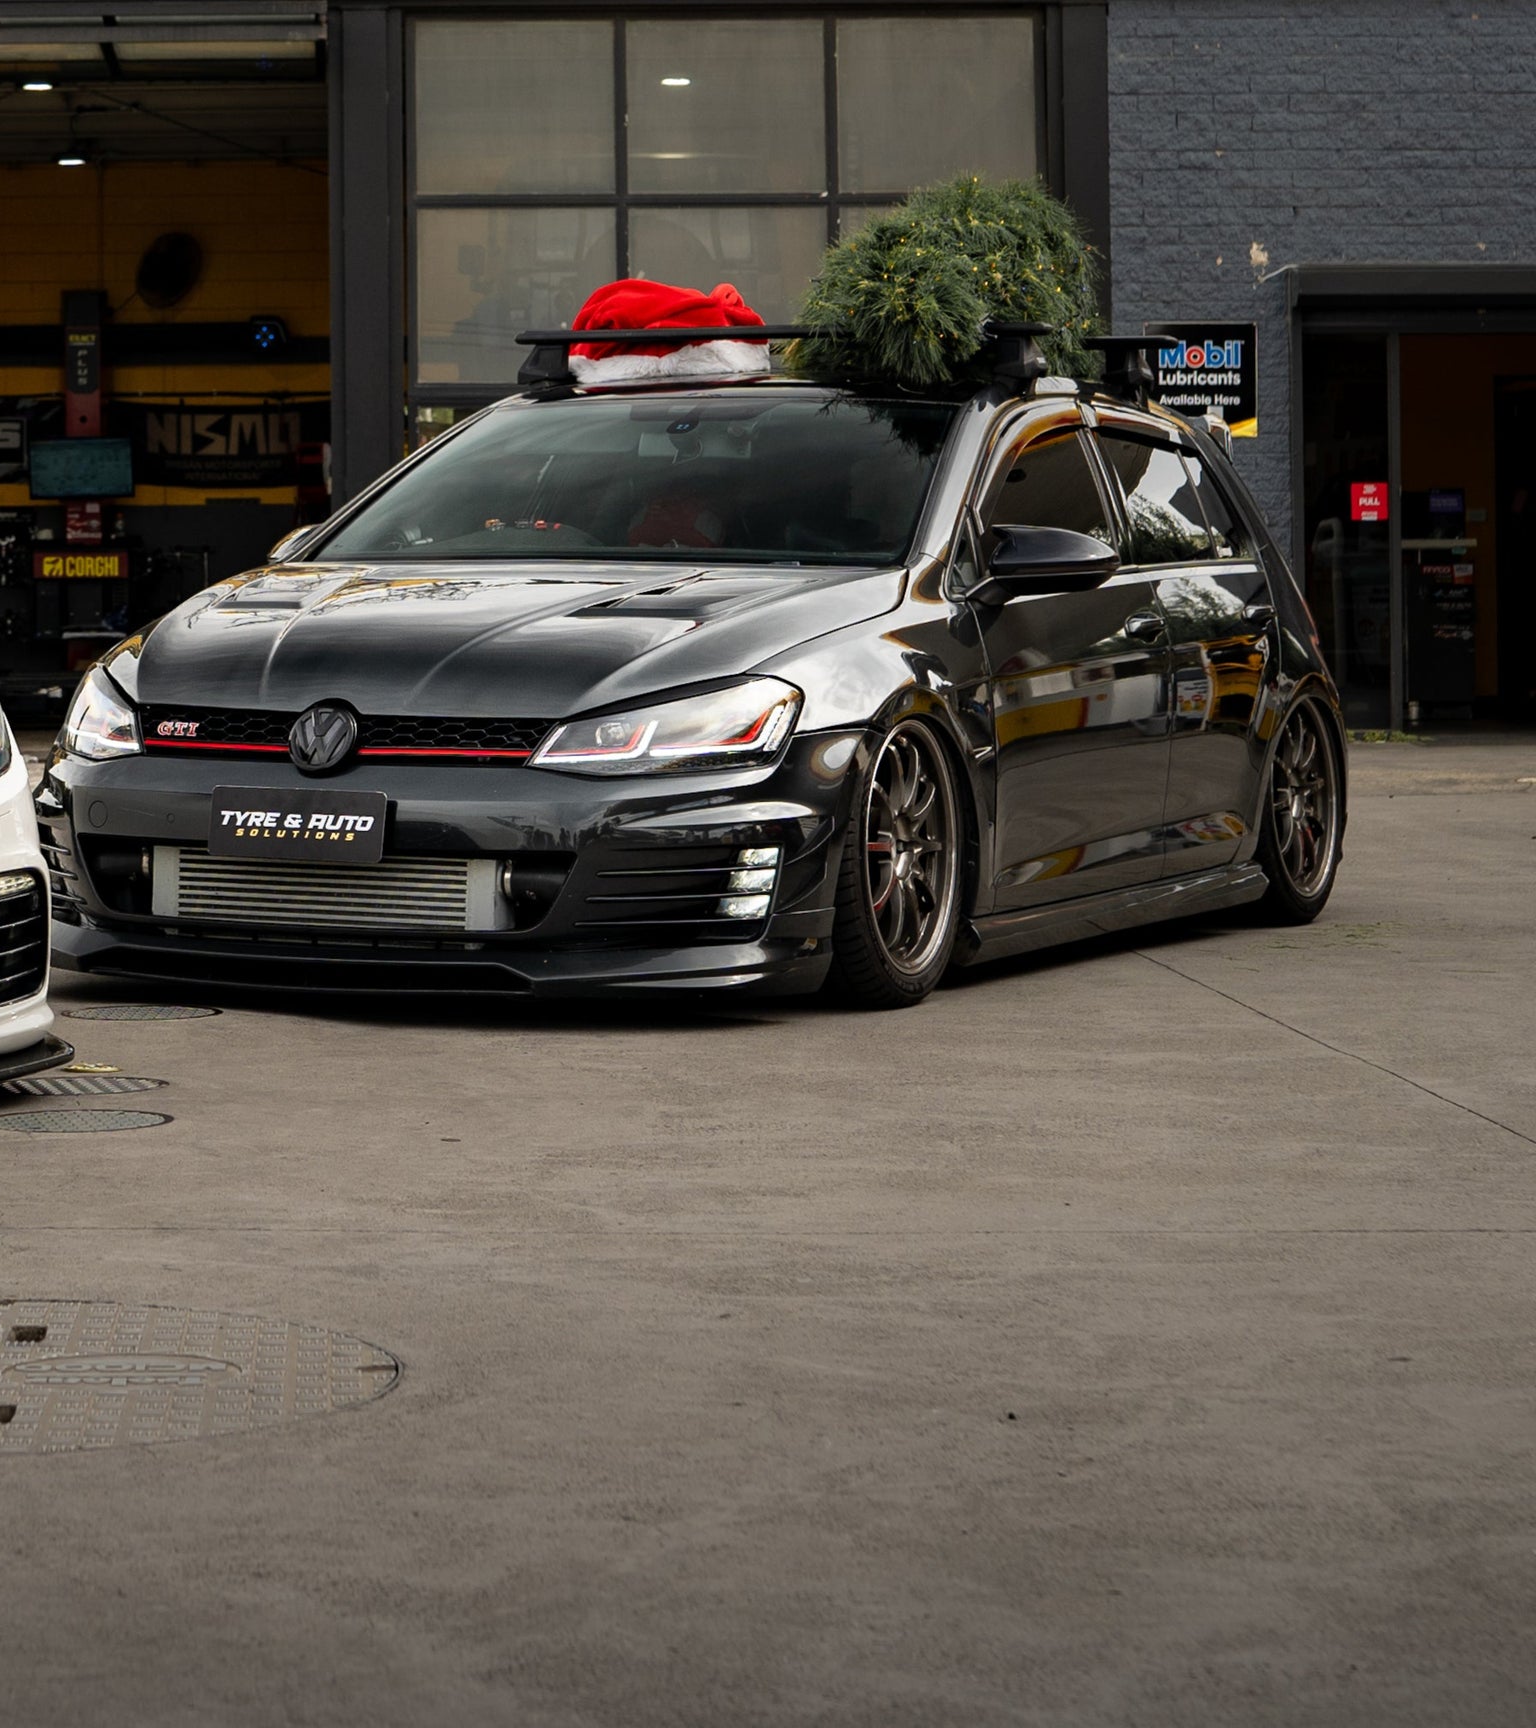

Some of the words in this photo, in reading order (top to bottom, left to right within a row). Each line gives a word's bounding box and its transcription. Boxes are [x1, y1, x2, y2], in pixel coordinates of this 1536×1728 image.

[1158, 340, 1241, 369] Mobil
[77, 350, 89, 385] PLUS
[1158, 371, 1241, 385] Lubricants
[1159, 394, 1212, 405] Available
[1214, 394, 1241, 405] Here
[146, 412, 301, 455] NISMO
[1359, 497, 1381, 506] PULL
[65, 556, 119, 577] CORGHI
[157, 721, 200, 736] GTI
[220, 810, 281, 828] TYRE
[284, 814, 303, 829] &
[308, 813, 375, 832] AUTO
[235, 828, 355, 841] SOLUTIONS
